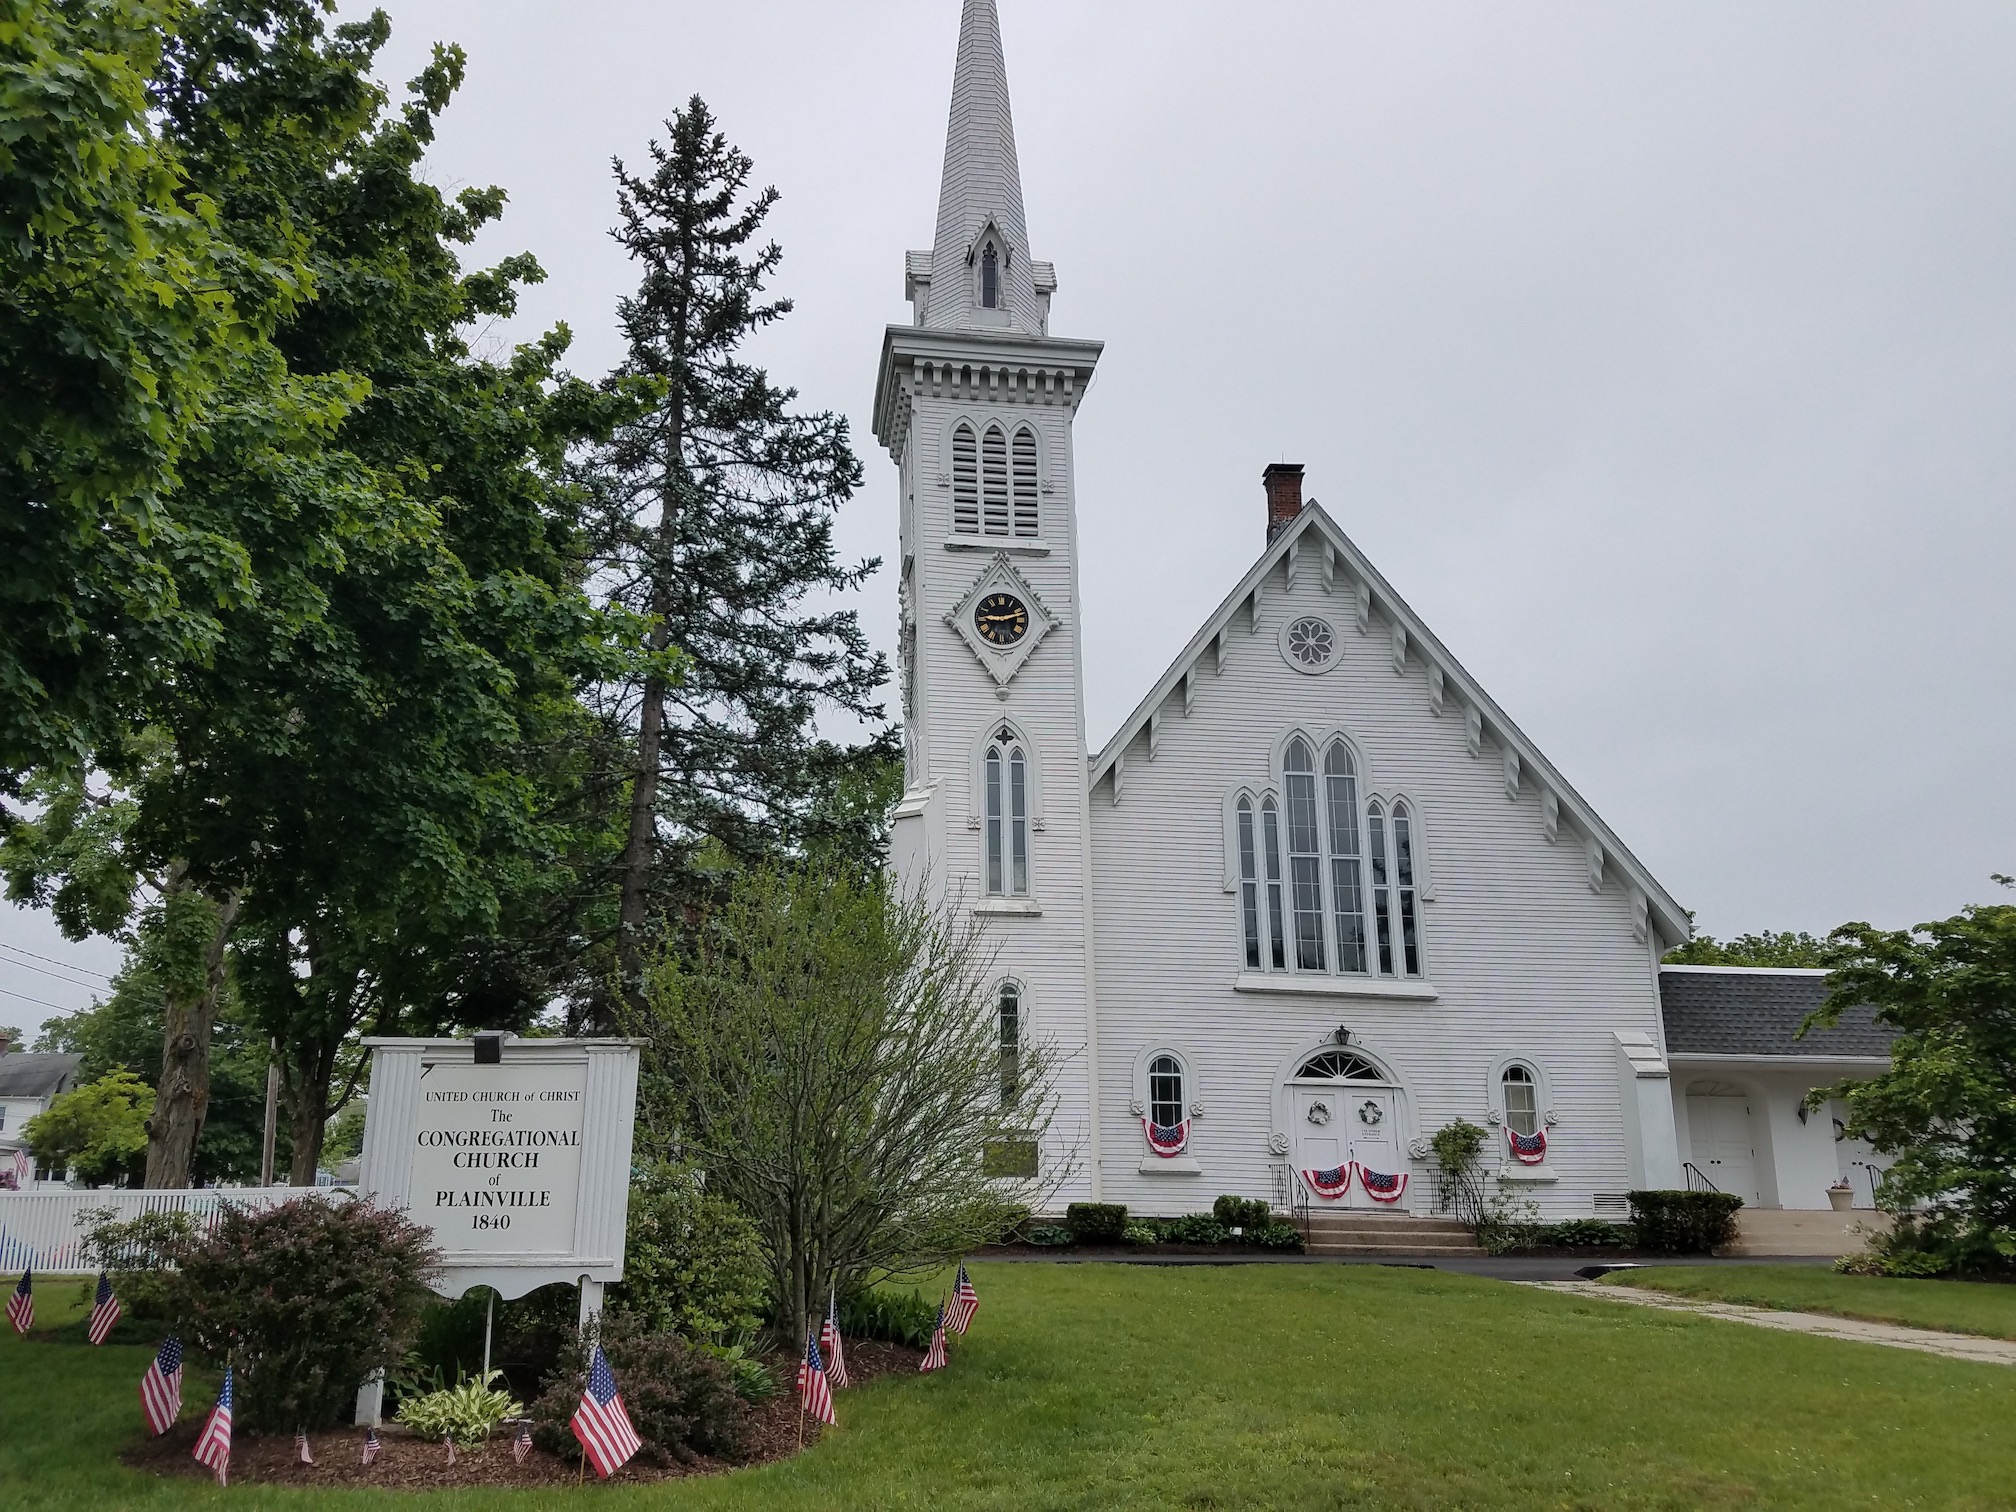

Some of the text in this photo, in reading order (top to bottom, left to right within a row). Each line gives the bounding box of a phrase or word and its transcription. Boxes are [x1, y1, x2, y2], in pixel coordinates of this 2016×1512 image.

[426, 1091, 581, 1102] UNITED CHURCH of CHRIST
[490, 1108, 513, 1123] The
[417, 1130, 580, 1147] CONGREGATIONAL
[453, 1151, 540, 1169] CHURCH
[488, 1173, 501, 1187] of
[434, 1190, 551, 1207] PLAINVILLE
[471, 1214, 511, 1230] 1840
